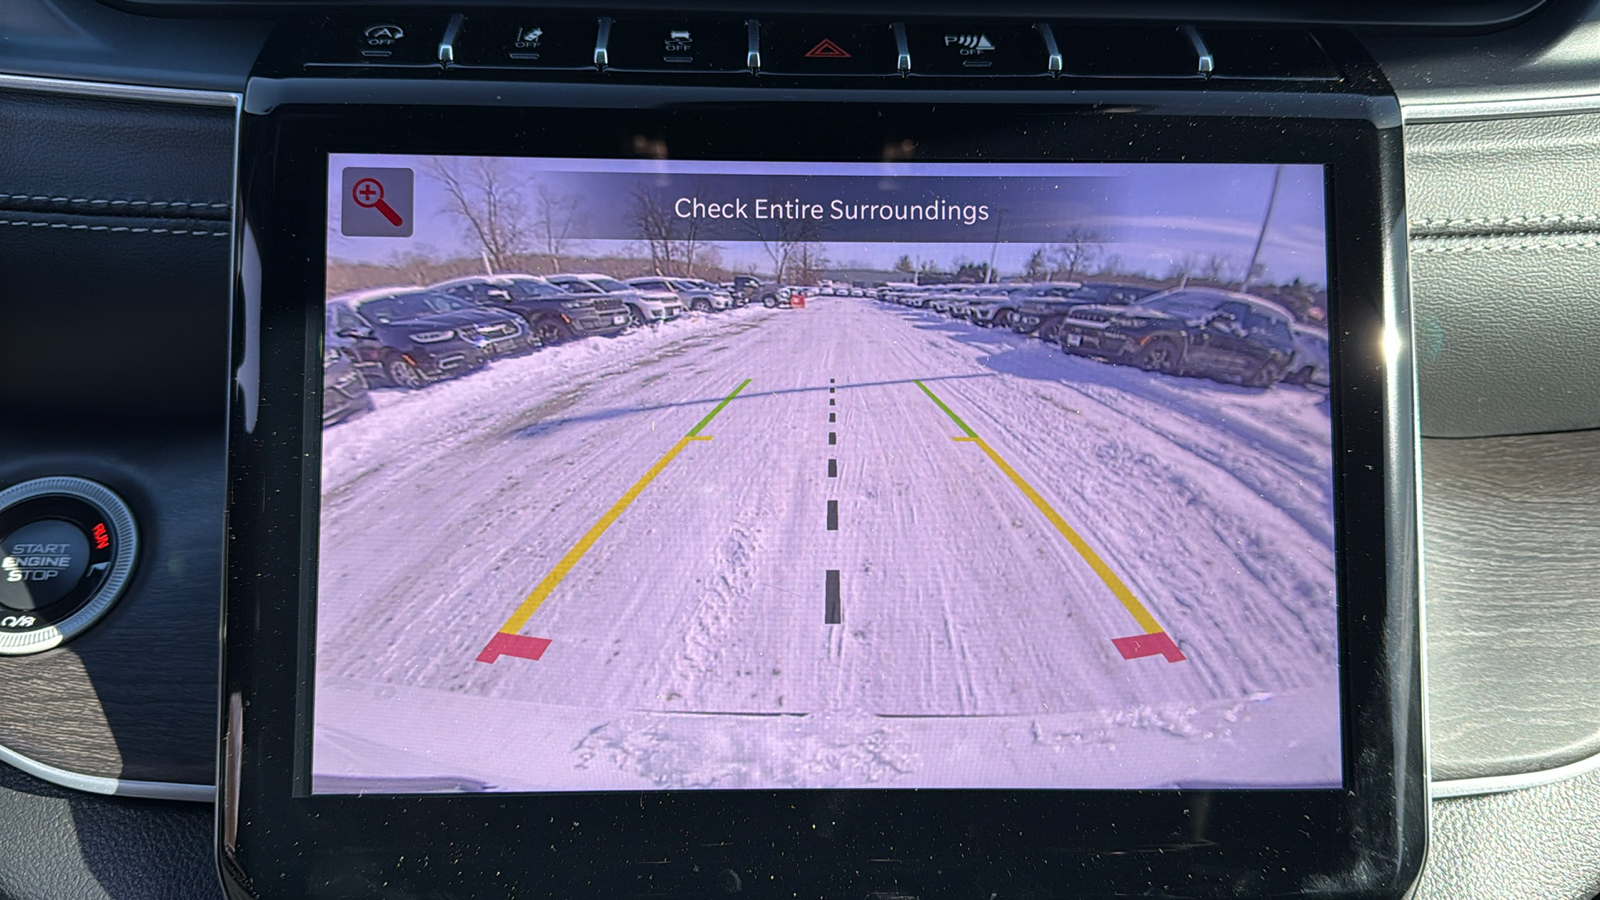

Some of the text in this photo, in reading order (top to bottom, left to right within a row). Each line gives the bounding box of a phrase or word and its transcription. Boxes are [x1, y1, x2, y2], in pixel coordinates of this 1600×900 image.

[674, 197, 990, 225] Check Entire Surroundings
[91, 523, 110, 550] RUN
[13, 543, 70, 554] START
[2, 557, 71, 568] ENGINE
[6, 570, 58, 582] STOP
